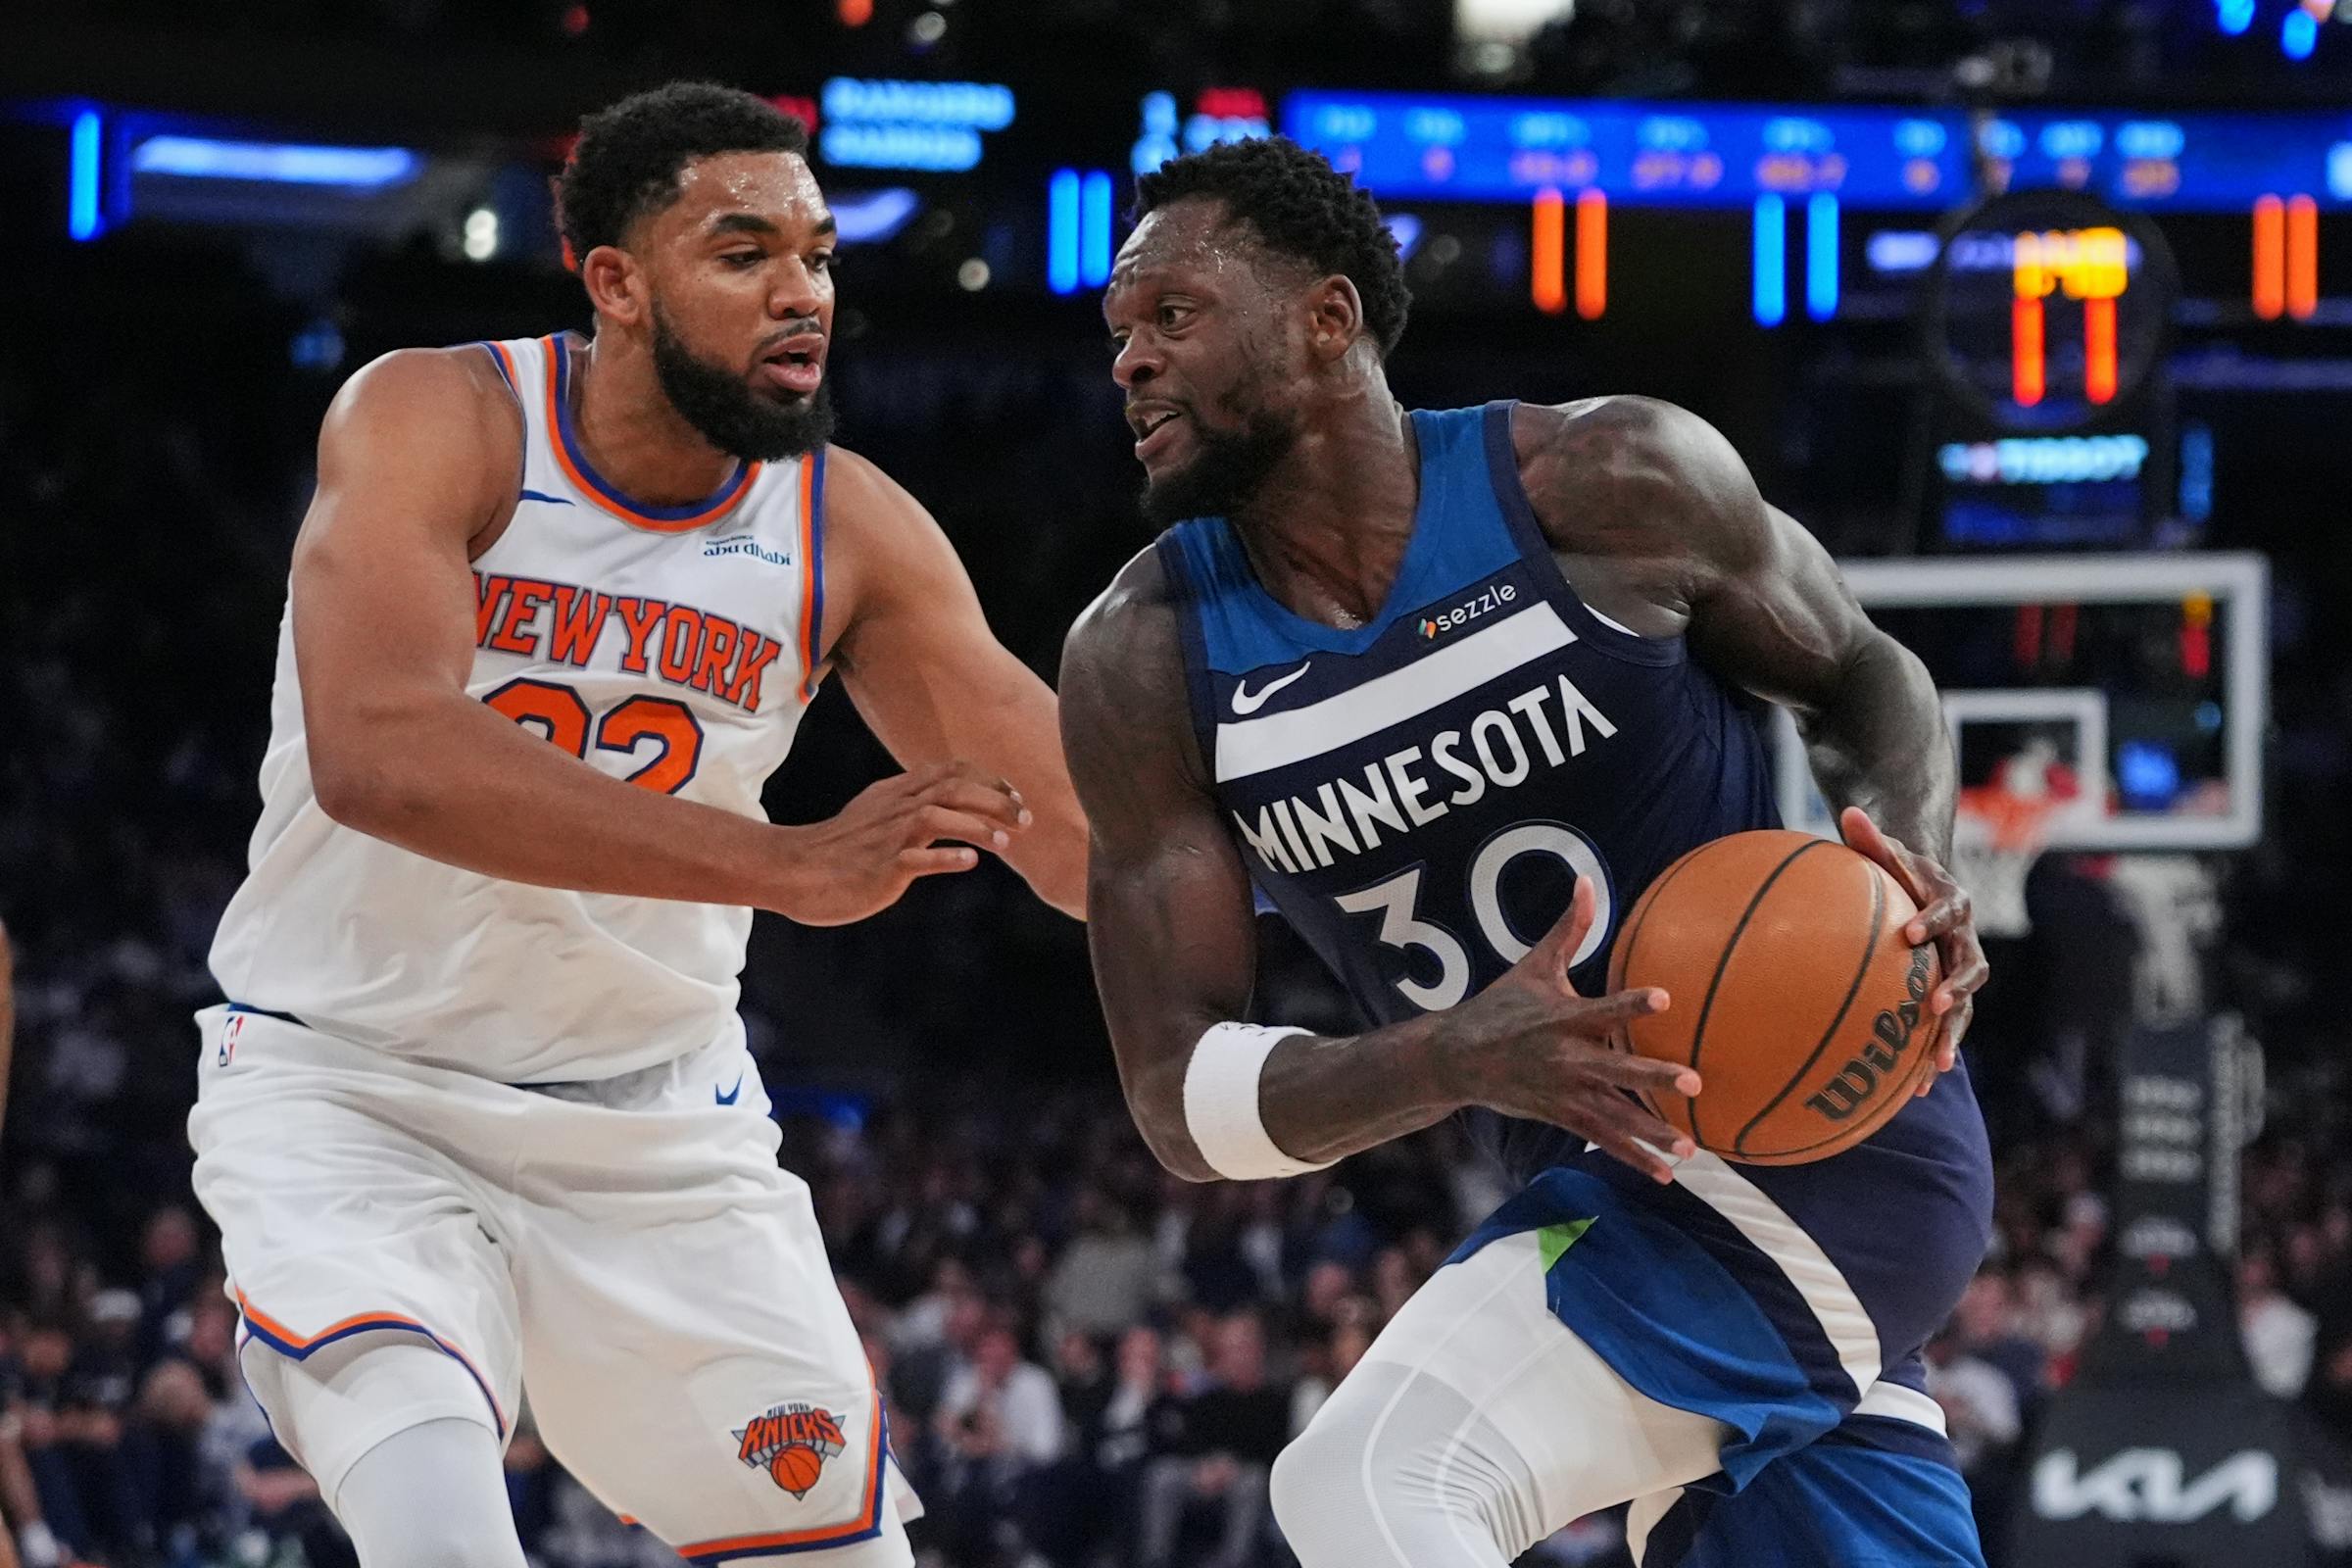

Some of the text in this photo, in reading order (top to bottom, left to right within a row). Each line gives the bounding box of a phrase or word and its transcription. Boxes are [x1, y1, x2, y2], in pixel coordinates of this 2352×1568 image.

[704, 543, 791, 565] abu dhabi
[1437, 585, 1516, 631] sezzle
[615, 596, 783, 713] YORK
[1233, 674, 1618, 873] MINNESOTA
[1334, 819, 1615, 1011] 30
[739, 1407, 847, 1460] KNICKS
[767, 1402, 811, 1418] NEW YORK
